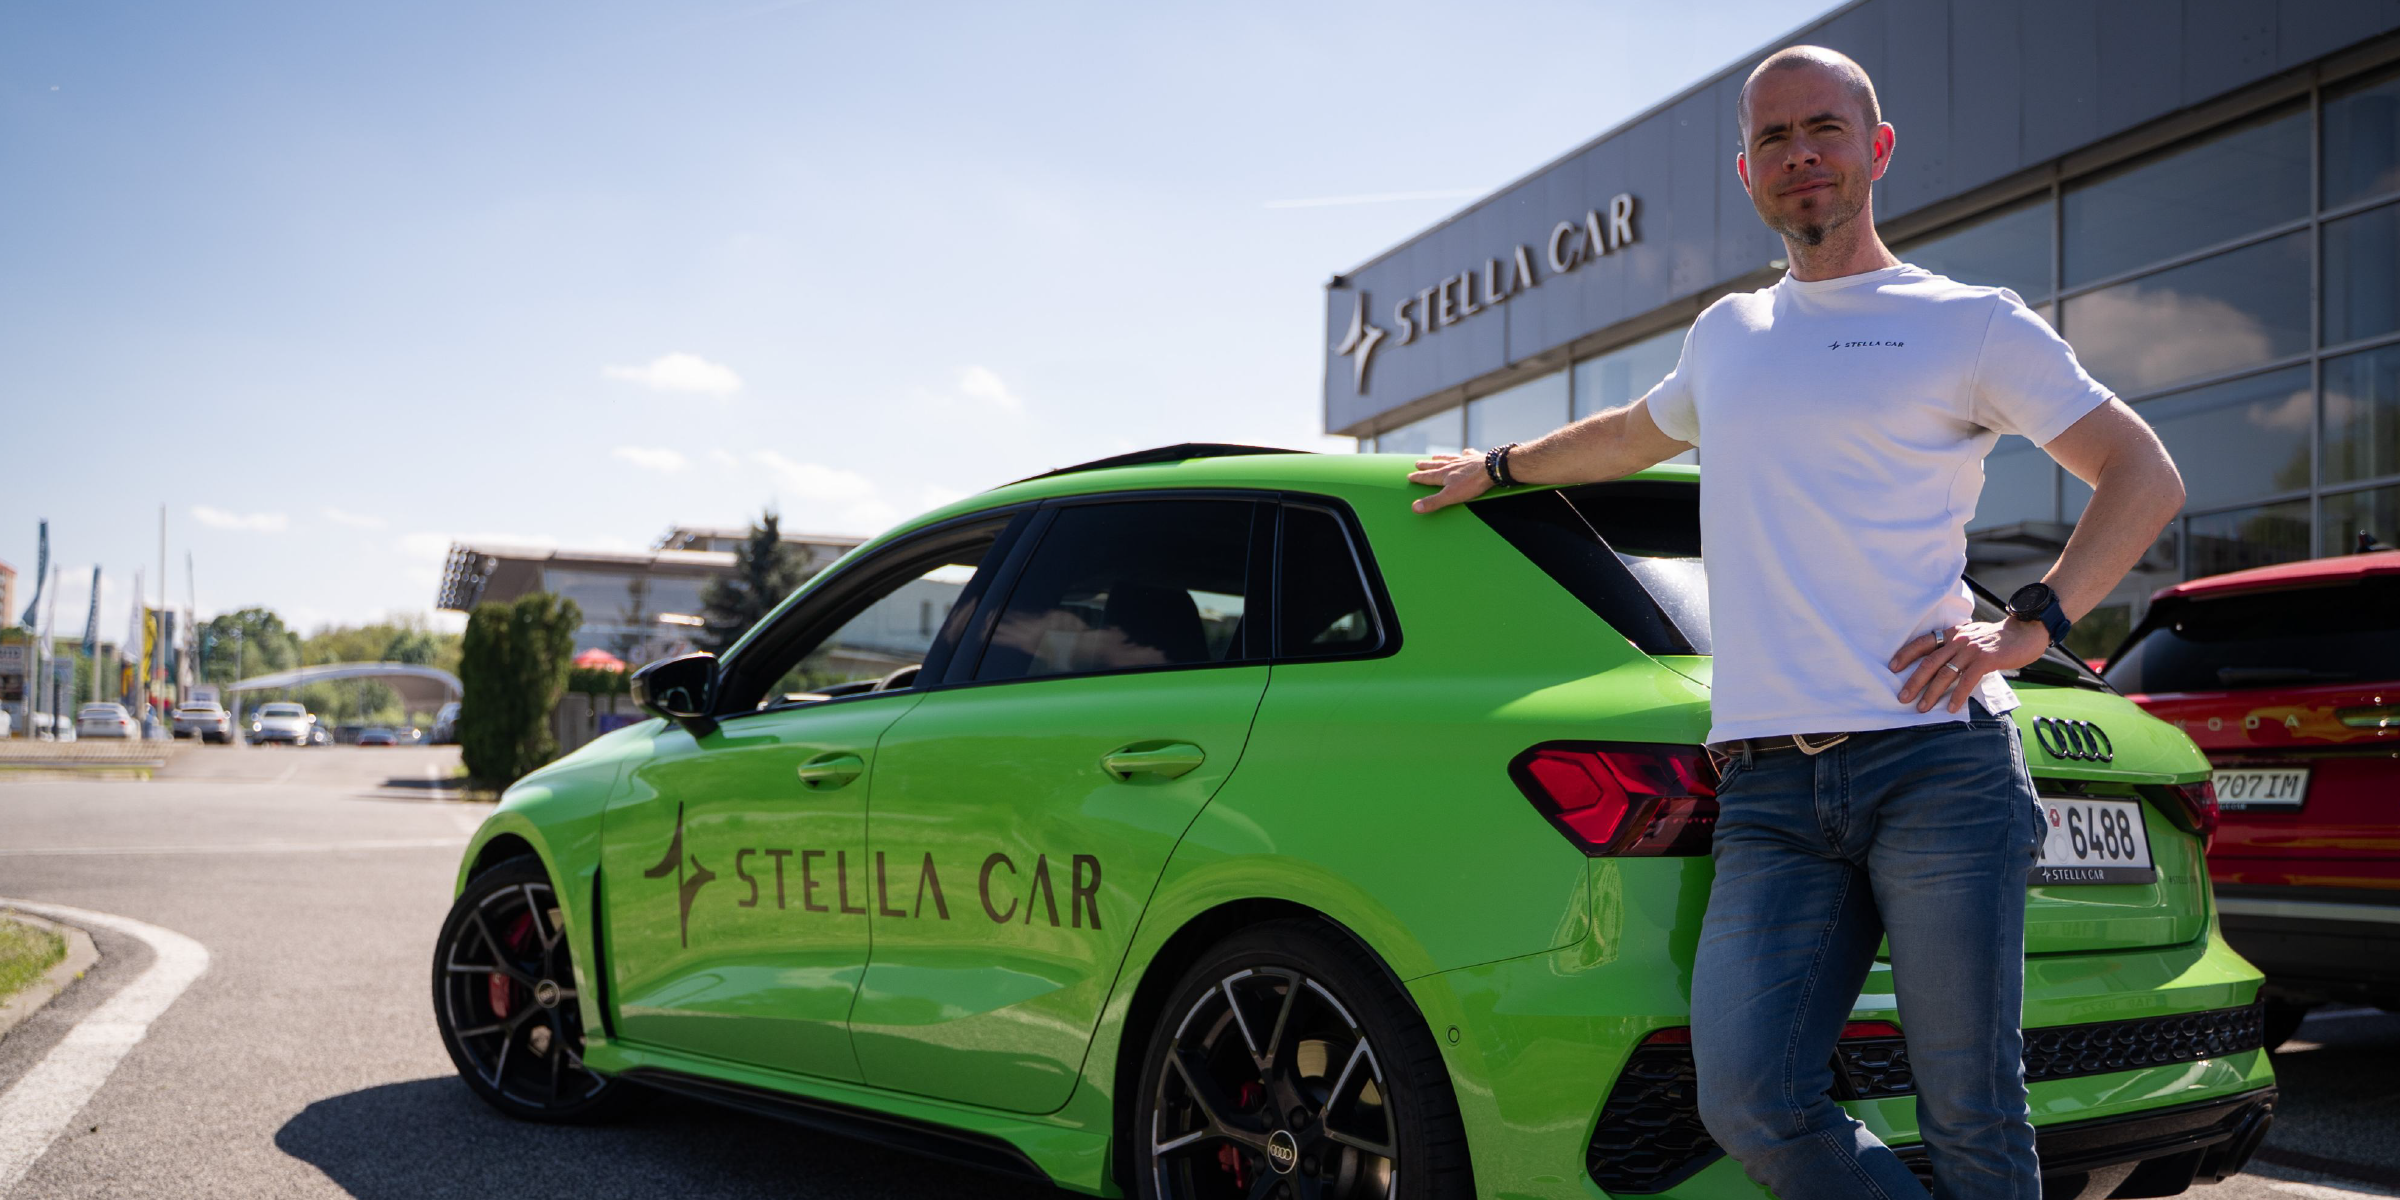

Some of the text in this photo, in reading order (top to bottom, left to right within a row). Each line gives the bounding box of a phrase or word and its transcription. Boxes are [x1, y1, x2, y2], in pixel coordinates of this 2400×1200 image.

[1394, 193, 1634, 346] STELLA CAR
[2174, 714, 2299, 732] KODA
[2217, 774, 2299, 798] 707IM
[2067, 806, 2135, 860] 6488
[735, 848, 1102, 930] STELLA CAR
[2052, 869, 2105, 880] STELLA CAR
